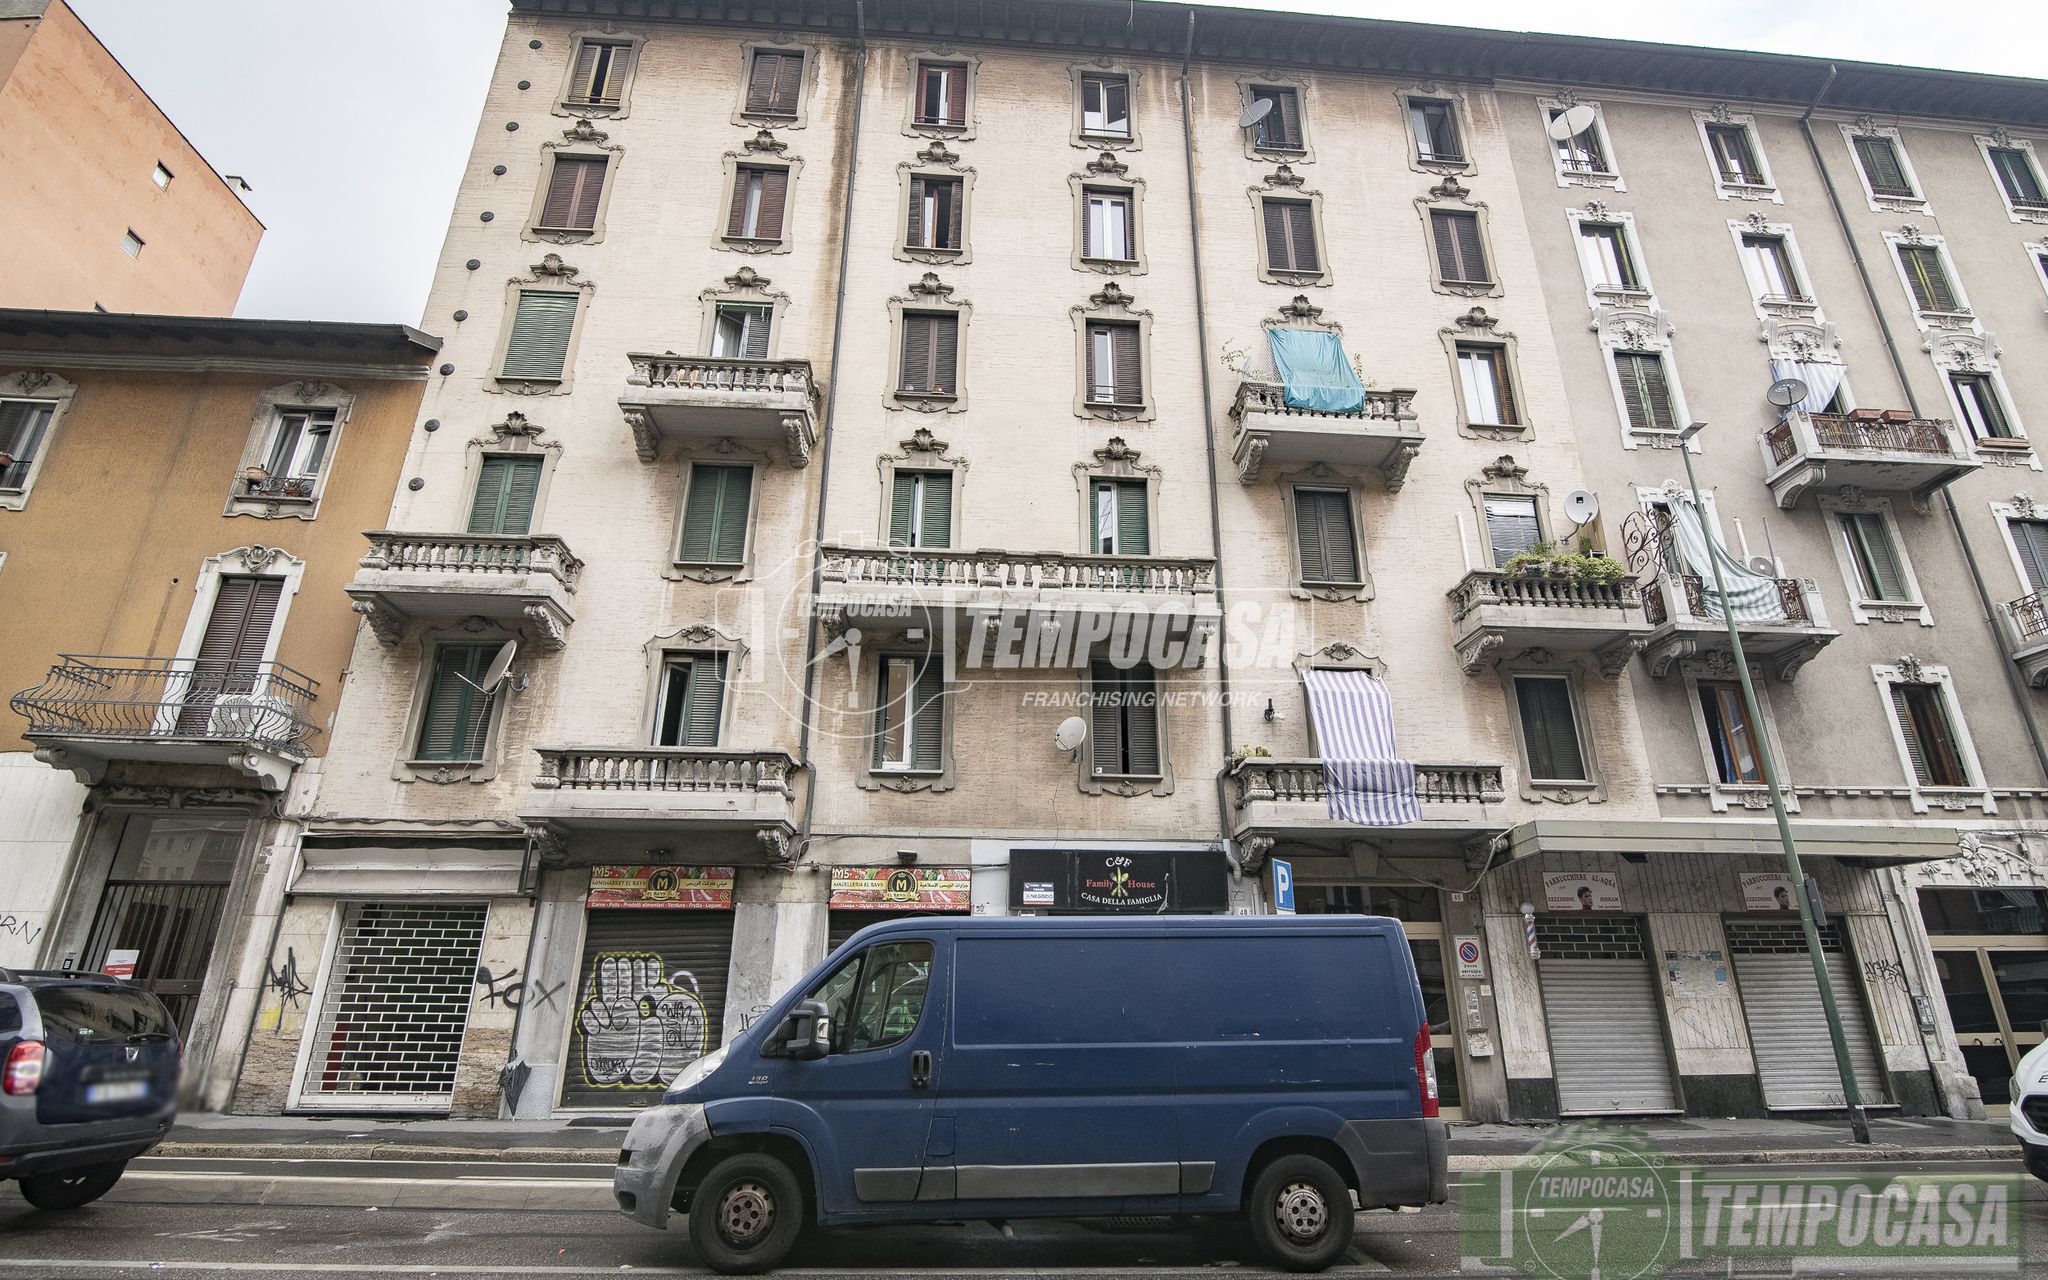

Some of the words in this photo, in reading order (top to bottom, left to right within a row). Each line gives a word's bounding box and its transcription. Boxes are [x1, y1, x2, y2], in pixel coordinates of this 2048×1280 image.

[1105, 856, 1133, 868] C&F
[656, 879, 668, 890] M
[896, 879, 907, 891] M
[1086, 879, 1114, 890] Family
[1127, 879, 1156, 889] House
[1276, 865, 1290, 904] P
[1545, 873, 1587, 888] PARRUCCHIERE
[1591, 874, 1616, 888] AL-AQSA
[1742, 873, 1782, 888] PARRUCCHIERE
[1081, 892, 1101, 904] CASA
[1102, 897, 1126, 906] DELLA
[1127, 893, 1163, 906] FAMIGLIA
